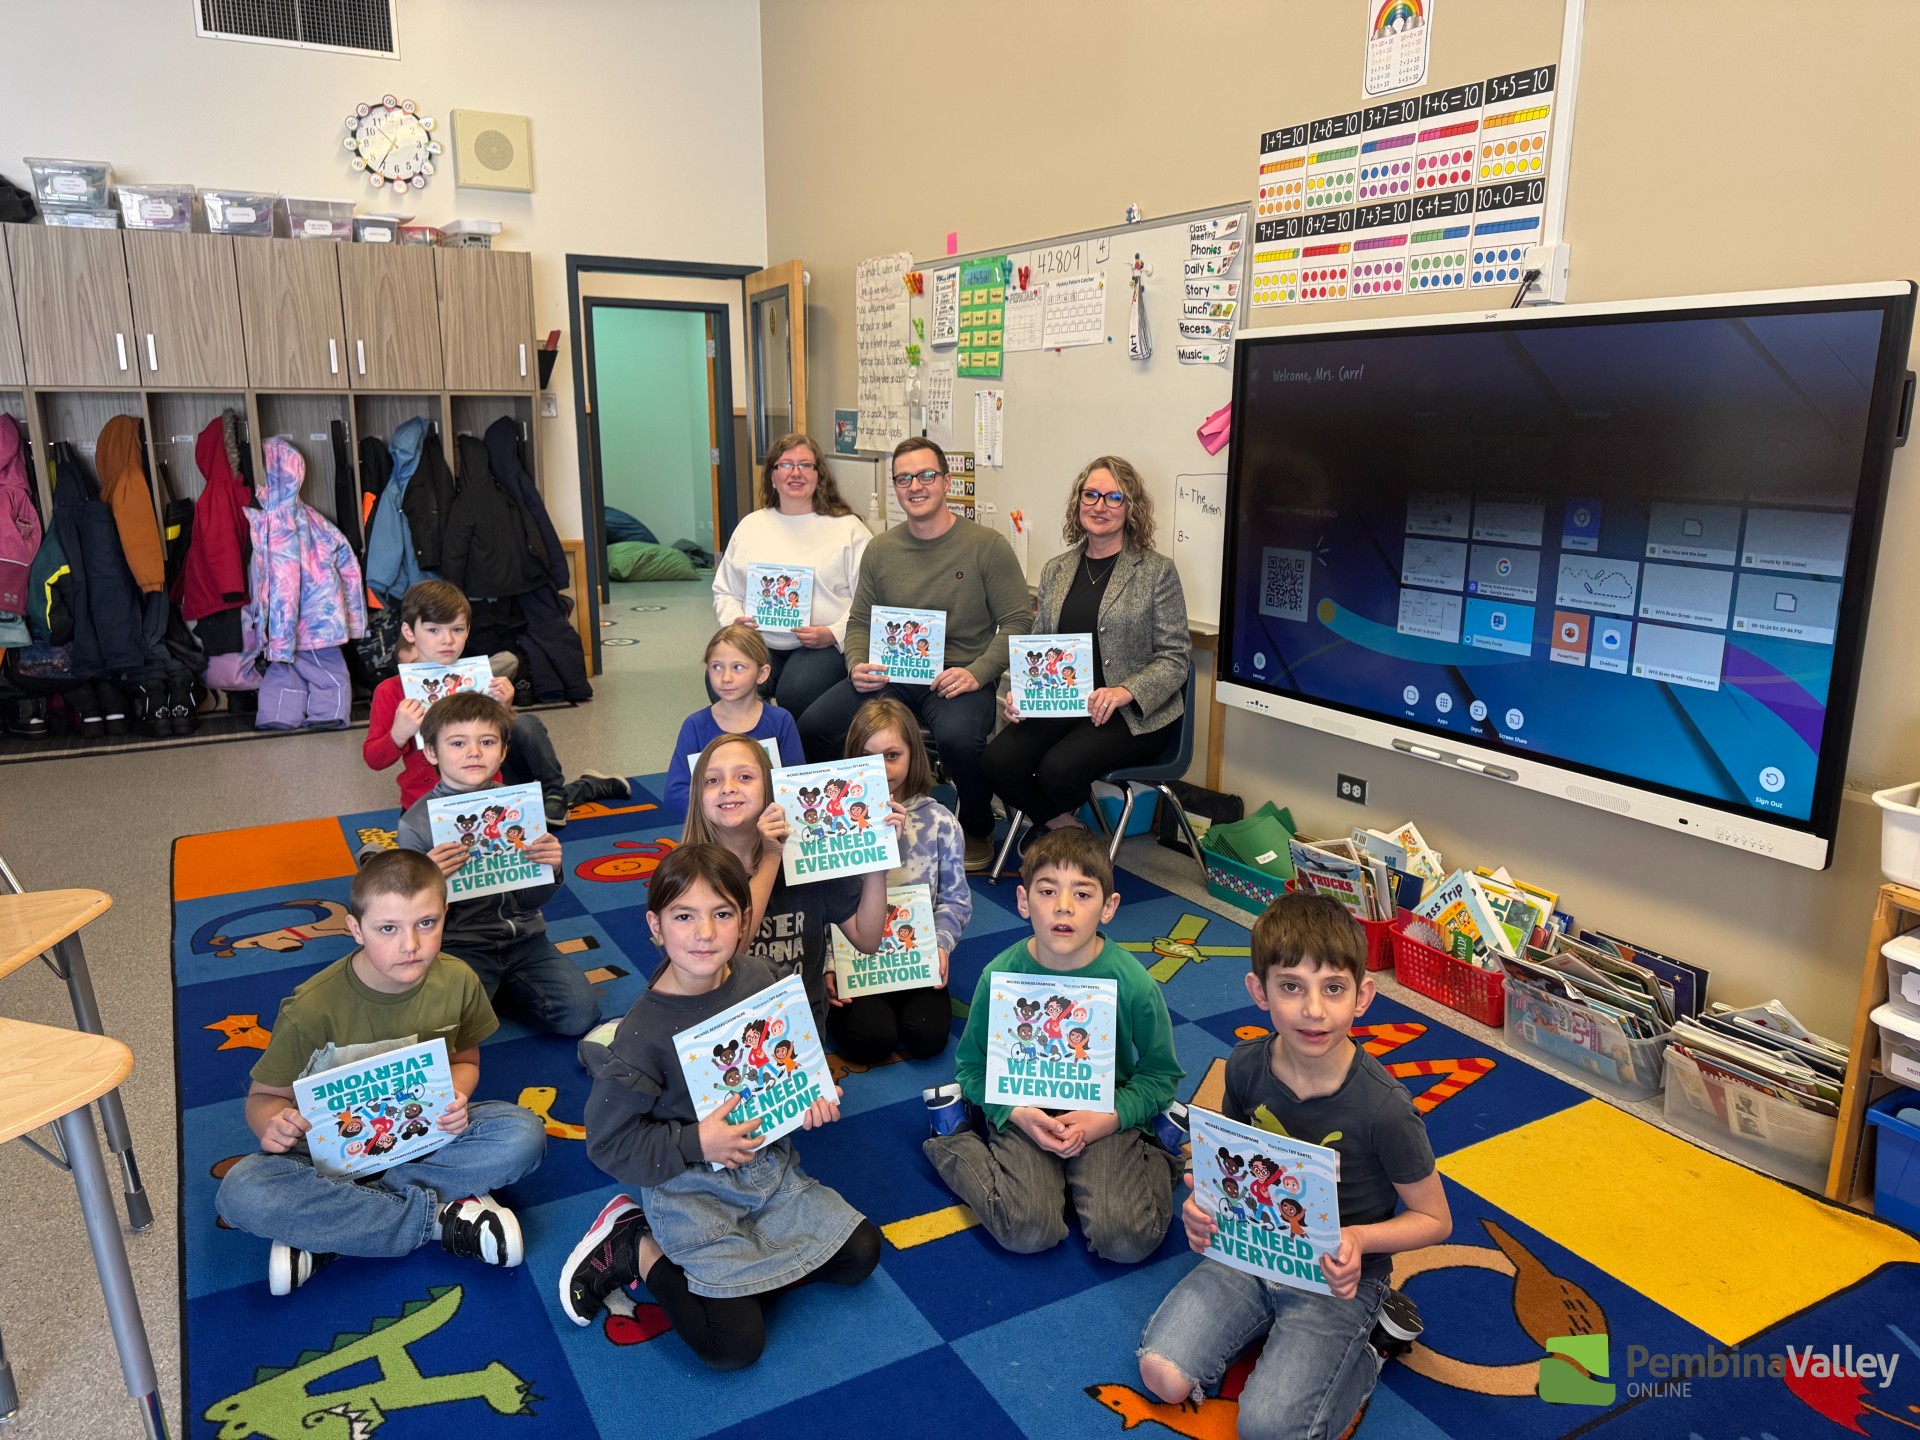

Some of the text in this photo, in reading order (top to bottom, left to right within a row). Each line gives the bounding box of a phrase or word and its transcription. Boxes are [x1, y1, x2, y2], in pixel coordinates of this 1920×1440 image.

[1190, 224, 1206, 234] Class
[1190, 231, 1216, 241] Meeting
[1192, 244, 1222, 255] Phonics
[1038, 244, 1080, 274] 42809
[1185, 264, 1204, 276] Daily
[1186, 285, 1210, 297] Story
[1184, 303, 1208, 314] Lunch
[1180, 322, 1209, 334] Recess
[1178, 350, 1202, 360] Music
[1273, 364, 1364, 383] Welcome, Mrs. Carr!
[966, 459, 974, 470] 60
[966, 483, 974, 494] 70
[1192, 488, 1206, 504] The
[966, 508, 974, 519] 80
[756, 606, 800, 618] WE NEED
[880, 655, 930, 668] WE NEED
[1024, 687, 1079, 699] WE NEED
[1020, 700, 1086, 710] EVERYONE
[1499, 733, 1514, 741] Screen
[1755, 796, 1784, 808] Sign Out
[799, 831, 877, 857] WE NEED
[458, 859, 484, 876] WE
[795, 846, 888, 875] EVERYONE
[452, 864, 542, 893] EVERYONE
[1308, 872, 1354, 893] TRUCKS
[1440, 884, 1462, 904] Trip
[852, 951, 922, 973] WE NEED
[847, 965, 930, 989] EVERYONE
[1007, 1058, 1092, 1080] WE NEED
[312, 1052, 434, 1101] EVERYONE
[327, 1079, 390, 1111] NEED
[998, 1076, 1100, 1101] EVERYONE
[724, 1071, 808, 1126] WE NEED
[1216, 1211, 1314, 1260] WE NEED
